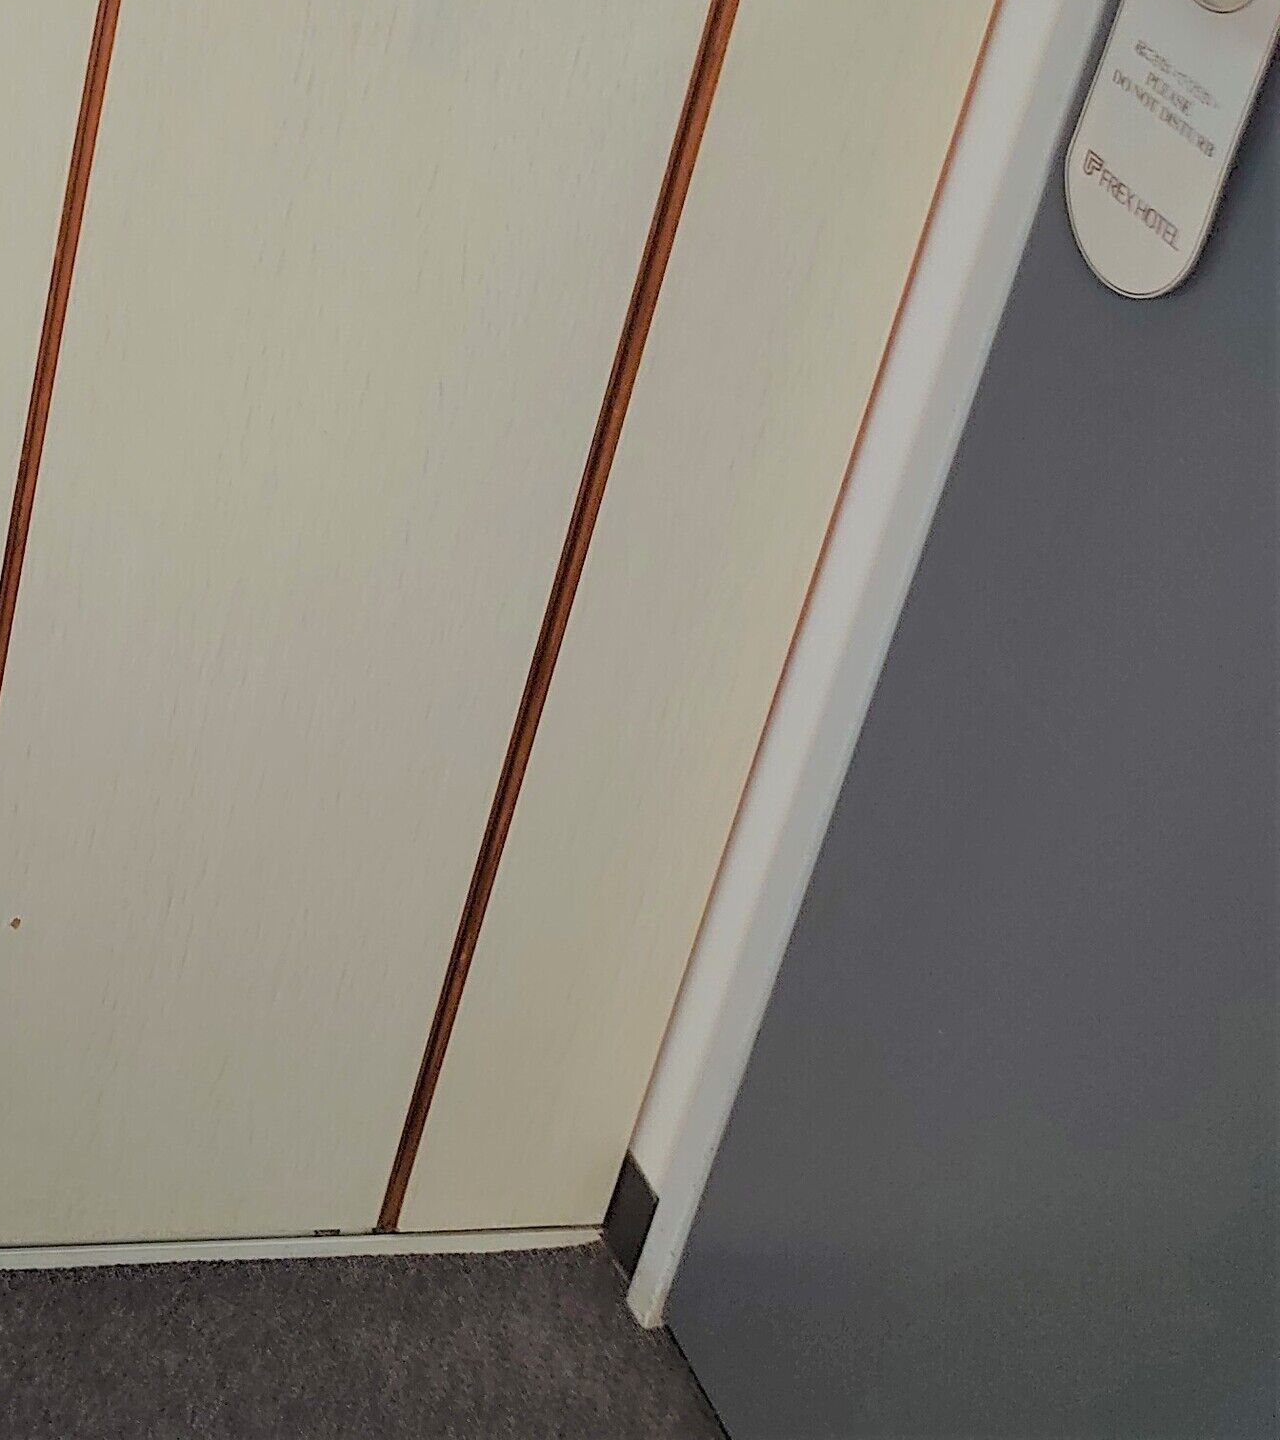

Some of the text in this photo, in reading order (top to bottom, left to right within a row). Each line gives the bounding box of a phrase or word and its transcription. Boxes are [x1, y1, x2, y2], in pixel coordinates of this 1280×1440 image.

[1113, 68, 1133, 93] DO
[1134, 84, 1158, 113] NOT
[1099, 168, 1137, 212] FREX
[1134, 199, 1180, 252] HOTEL
